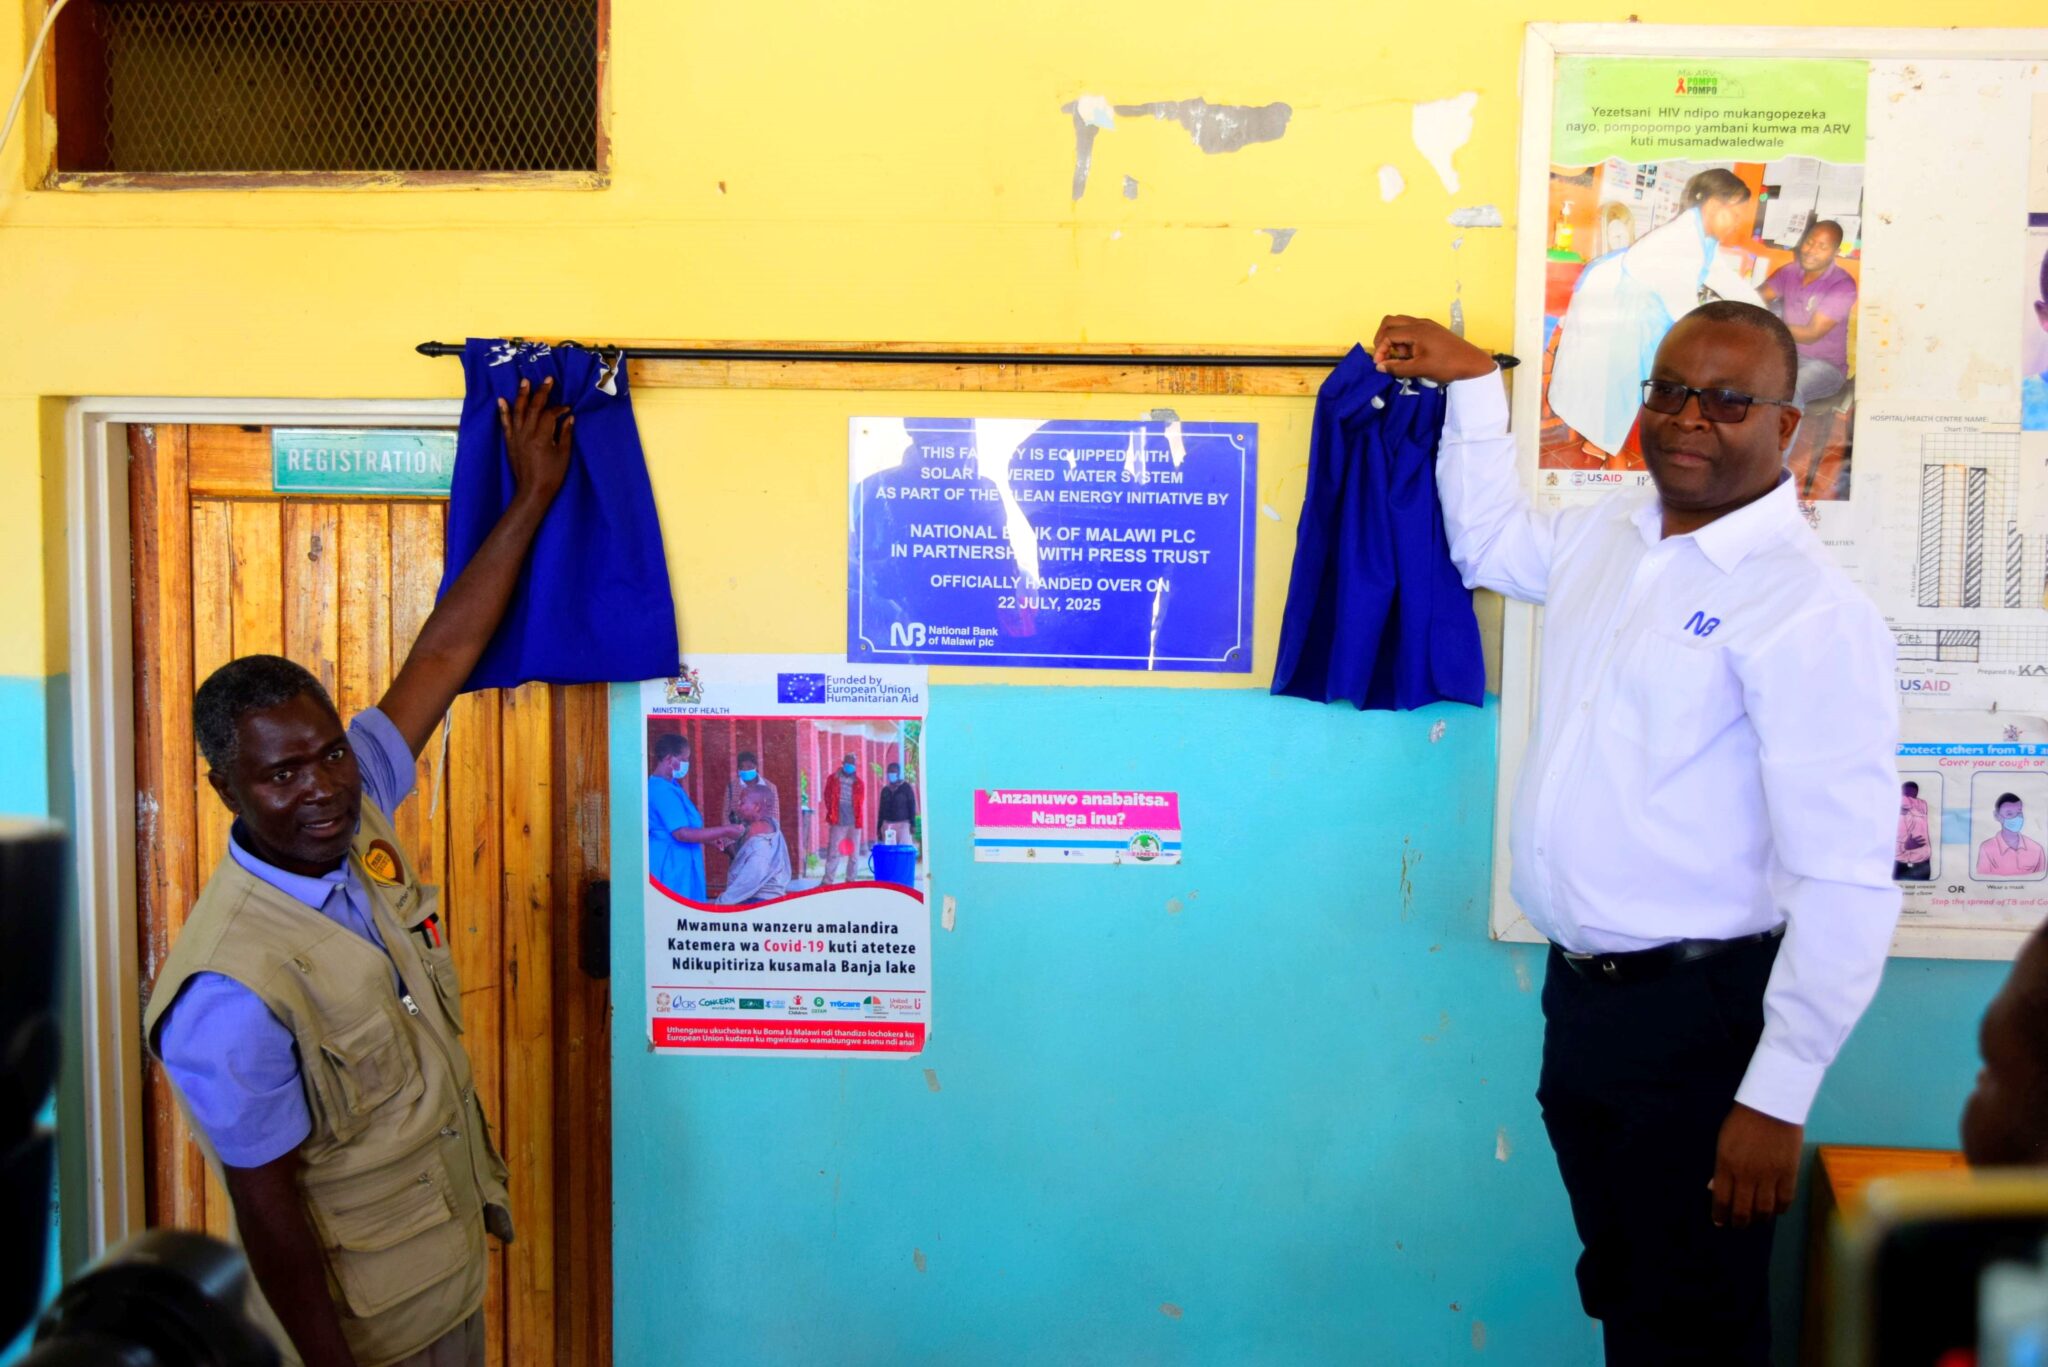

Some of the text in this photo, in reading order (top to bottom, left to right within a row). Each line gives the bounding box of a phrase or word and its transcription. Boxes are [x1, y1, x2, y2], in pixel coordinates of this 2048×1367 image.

[1687, 78, 1718, 86] POMPO
[1687, 86, 1718, 95] POMPO
[1592, 106, 1826, 122] Yezetsani HIV ndipo mukangopezeka
[1604, 122, 1691, 136] pompopompo
[1694, 121, 1748, 136] yambani
[1752, 122, 1797, 134] kumwa
[1801, 125, 1819, 134] ma
[1823, 123, 1851, 134] ARV
[1630, 135, 1785, 148] kuti musamadwaledwale
[1870, 415, 1934, 423] HOSPITAL/HEALTH
[921, 446, 955, 459] THIS
[1030, 449, 1044, 461] IS
[1048, 449, 1126, 463] EQUIPPED
[287, 449, 443, 474] REGISTRATION
[921, 466, 973, 480] SOLAR
[1063, 469, 1117, 482] WATER
[1121, 470, 1183, 484] SYSTEM
[1587, 473, 1623, 482] USAID
[875, 486, 1229, 506] AS PART OF THE LEAN ENERGY INITIATIVE BY
[910, 523, 998, 539] NATIONAL
[1056, 526, 1080, 541] OF
[1086, 527, 1156, 542] MALAWI
[1161, 529, 1196, 543] PLC
[891, 543, 1210, 564] IN PARTNERSH WITH PRESS TRUST
[930, 574, 1170, 592] OFFICIALLY HANDED OVER ON
[998, 596, 1101, 612] 22 JULY, 2025
[890, 621, 926, 647] NB
[928, 625, 998, 637] National Bank
[928, 636, 994, 648] of Malawi plc
[826, 675, 882, 687] Funded by
[1900, 679, 1951, 692] USAID
[826, 685, 911, 696] European Union
[826, 693, 919, 704] Humanitarian Aid
[652, 706, 687, 714] MINISTRY
[700, 707, 730, 715] HEALTH
[1895, 744, 1942, 755] Protect
[1945, 744, 1985, 755] others
[1987, 744, 2016, 755] from
[2018, 744, 2036, 754] TB
[1938, 757, 2046, 769] Cover your cough or
[988, 790, 1169, 807] Anzanuwo anabaitsa.
[1031, 811, 1126, 828] Nanga inu?
[1947, 884, 1966, 894] OR
[1931, 898, 1950, 908] Stop
[1952, 897, 1965, 906] the
[1967, 898, 1995, 907] spread
[2007, 898, 2017, 906] TB
[2019, 898, 2035, 906] and
[677, 918, 898, 935] Mwamuna wanzeru amalandira
[668, 937, 916, 954] Katemera wa Covid-19 kuti ateteze
[672, 957, 916, 976] Ndikupitiriza kusamala Banja lake
[666, 1026, 709, 1036] Uthengawu
[709, 1026, 752, 1035] ukuchokera
[753, 1027, 763, 1035] ku
[763, 1028, 784, 1036] Boma
[793, 1028, 821, 1036] Malawi
[834, 1029, 867, 1037] thandizo
[867, 1029, 904, 1038] lochokera
[905, 1030, 915, 1038] ku
[666, 1034, 701, 1042] European
[702, 1034, 725, 1042] Union
[755, 1035, 765, 1043] ku
[810, 1036, 861, 1046] wamabungwe
[886, 1037, 898, 1046] ndi
